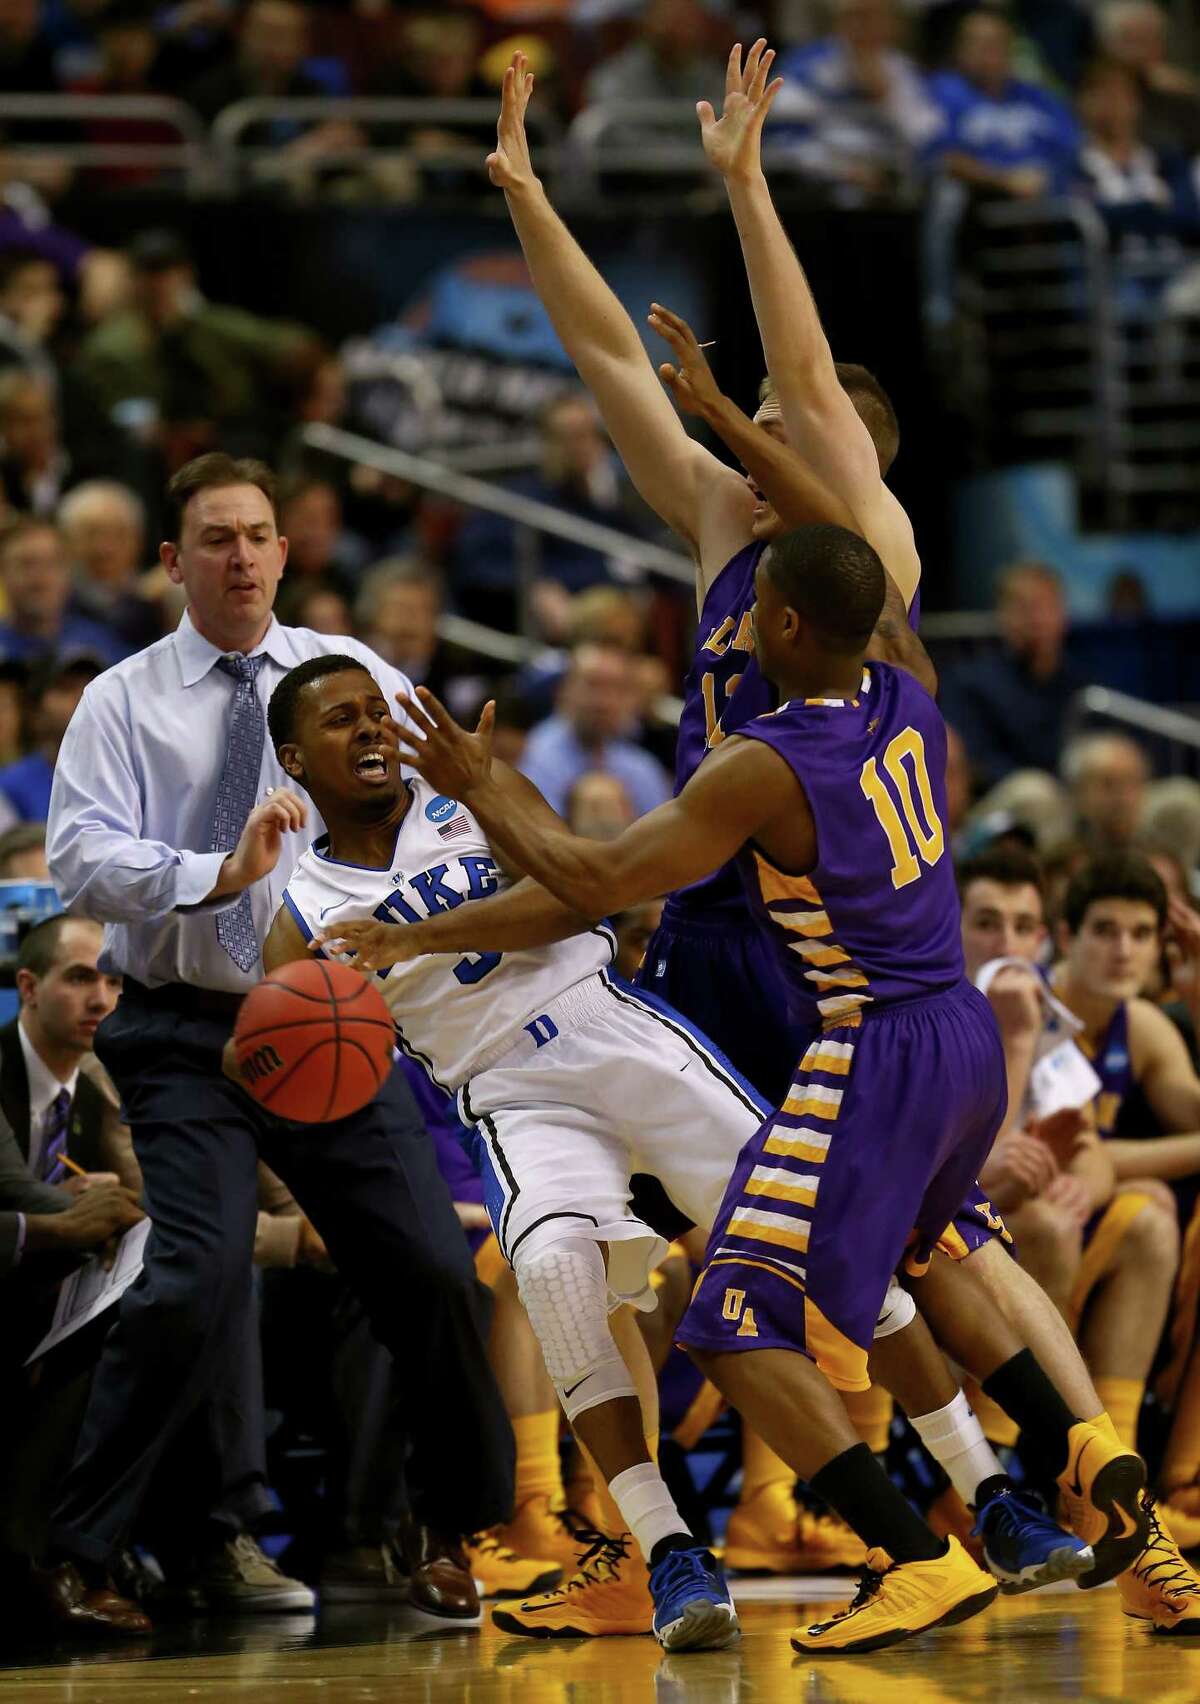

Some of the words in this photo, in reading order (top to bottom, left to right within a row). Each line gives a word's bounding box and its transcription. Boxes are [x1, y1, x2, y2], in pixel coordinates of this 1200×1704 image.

[431, 799, 457, 819] NCAA
[860, 727, 944, 890] 10
[523, 1014, 559, 1049] D
[722, 1288, 759, 1337] UA
